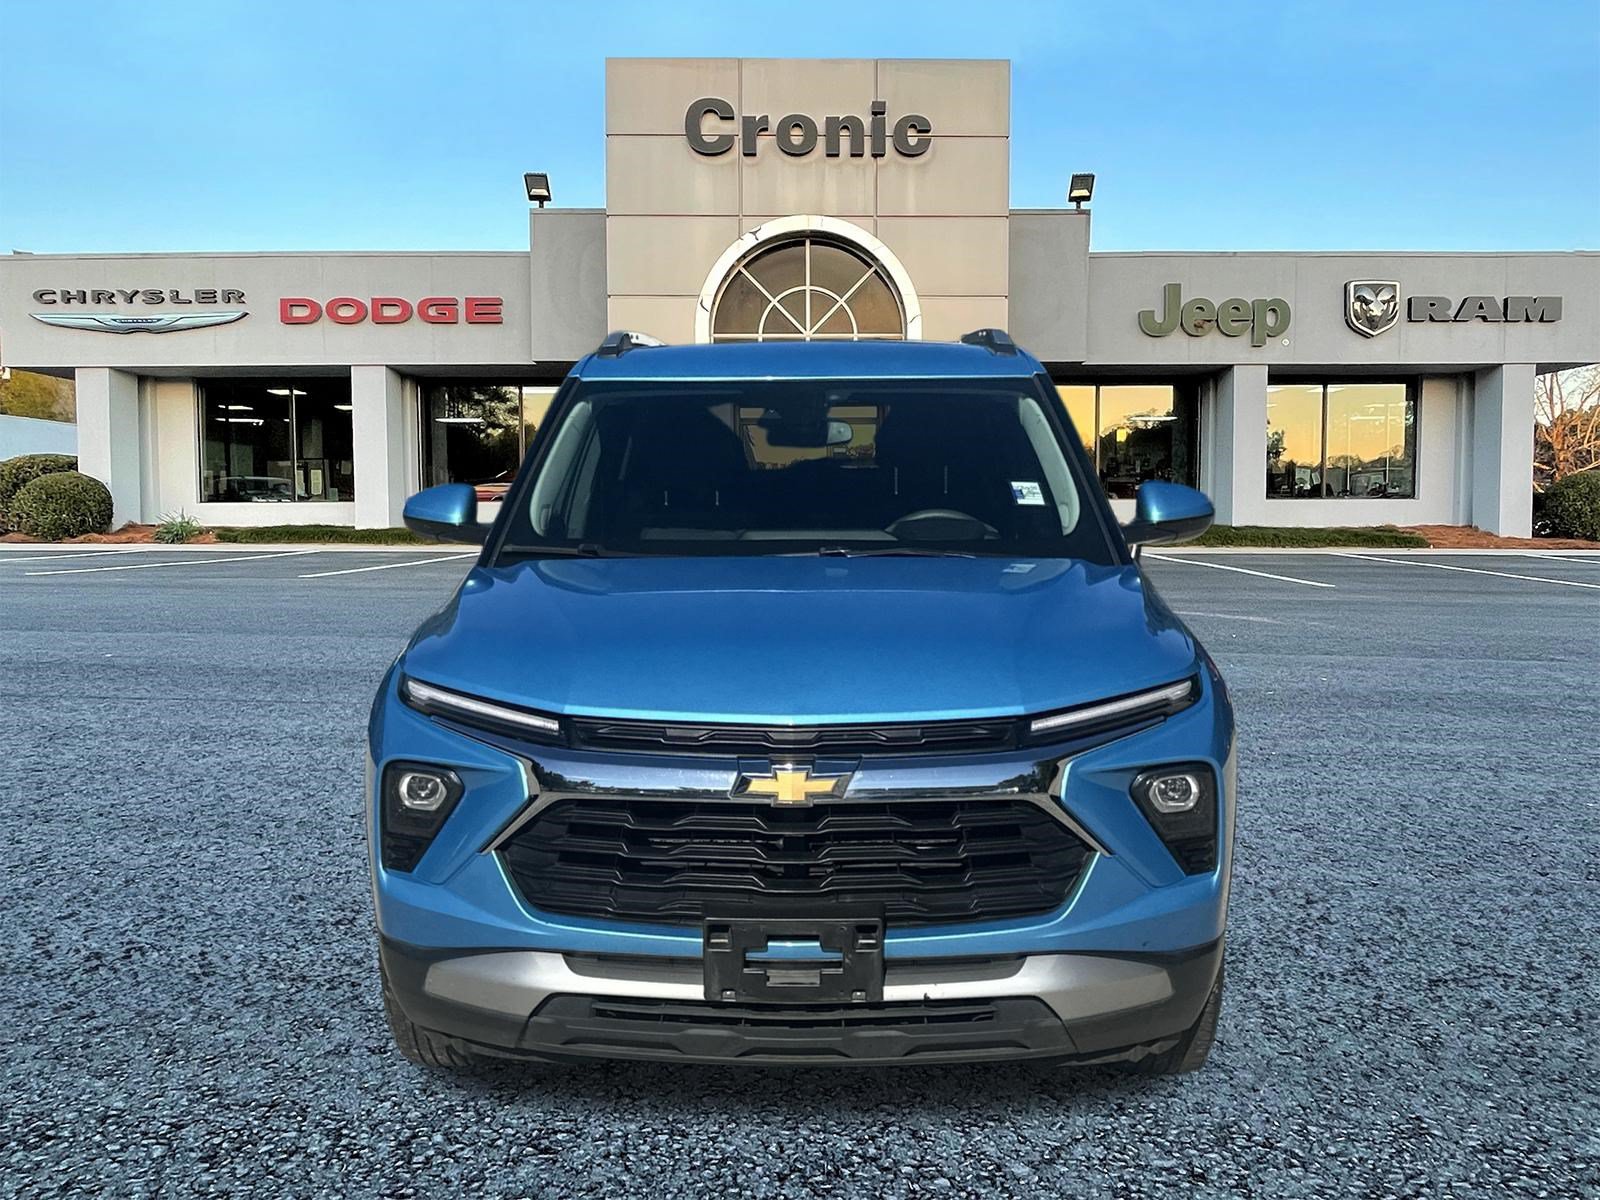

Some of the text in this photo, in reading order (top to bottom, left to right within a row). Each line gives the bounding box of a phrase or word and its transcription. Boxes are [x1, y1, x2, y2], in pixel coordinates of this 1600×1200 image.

[685, 97, 932, 157] Cronic
[32, 289, 246, 304] CHRYSLER
[1407, 296, 1563, 322] RAM
[279, 297, 503, 324] DODGE
[1138, 283, 1291, 347] Jeep
